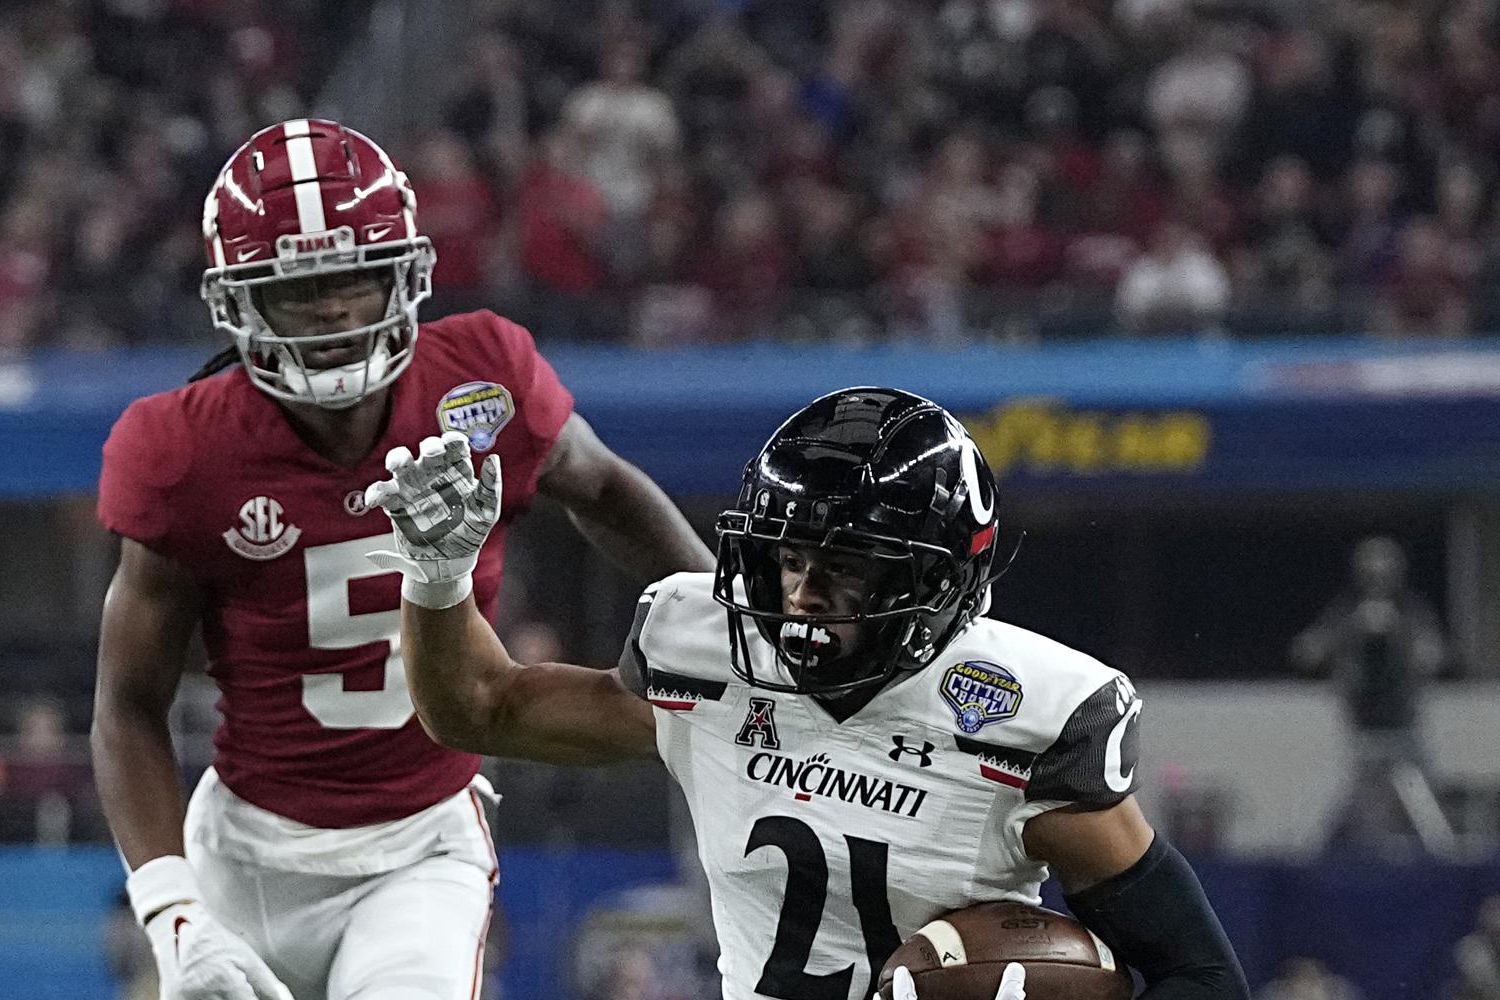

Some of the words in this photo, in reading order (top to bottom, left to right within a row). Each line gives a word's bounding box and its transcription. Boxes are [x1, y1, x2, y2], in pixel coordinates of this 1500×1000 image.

[238, 496, 285, 542] SEC
[301, 532, 417, 729] 5
[948, 673, 1017, 713] COTTON
[955, 664, 1020, 692] GOODYEAR
[956, 690, 999, 714] BOWL
[746, 751, 928, 818] CINCINNATI
